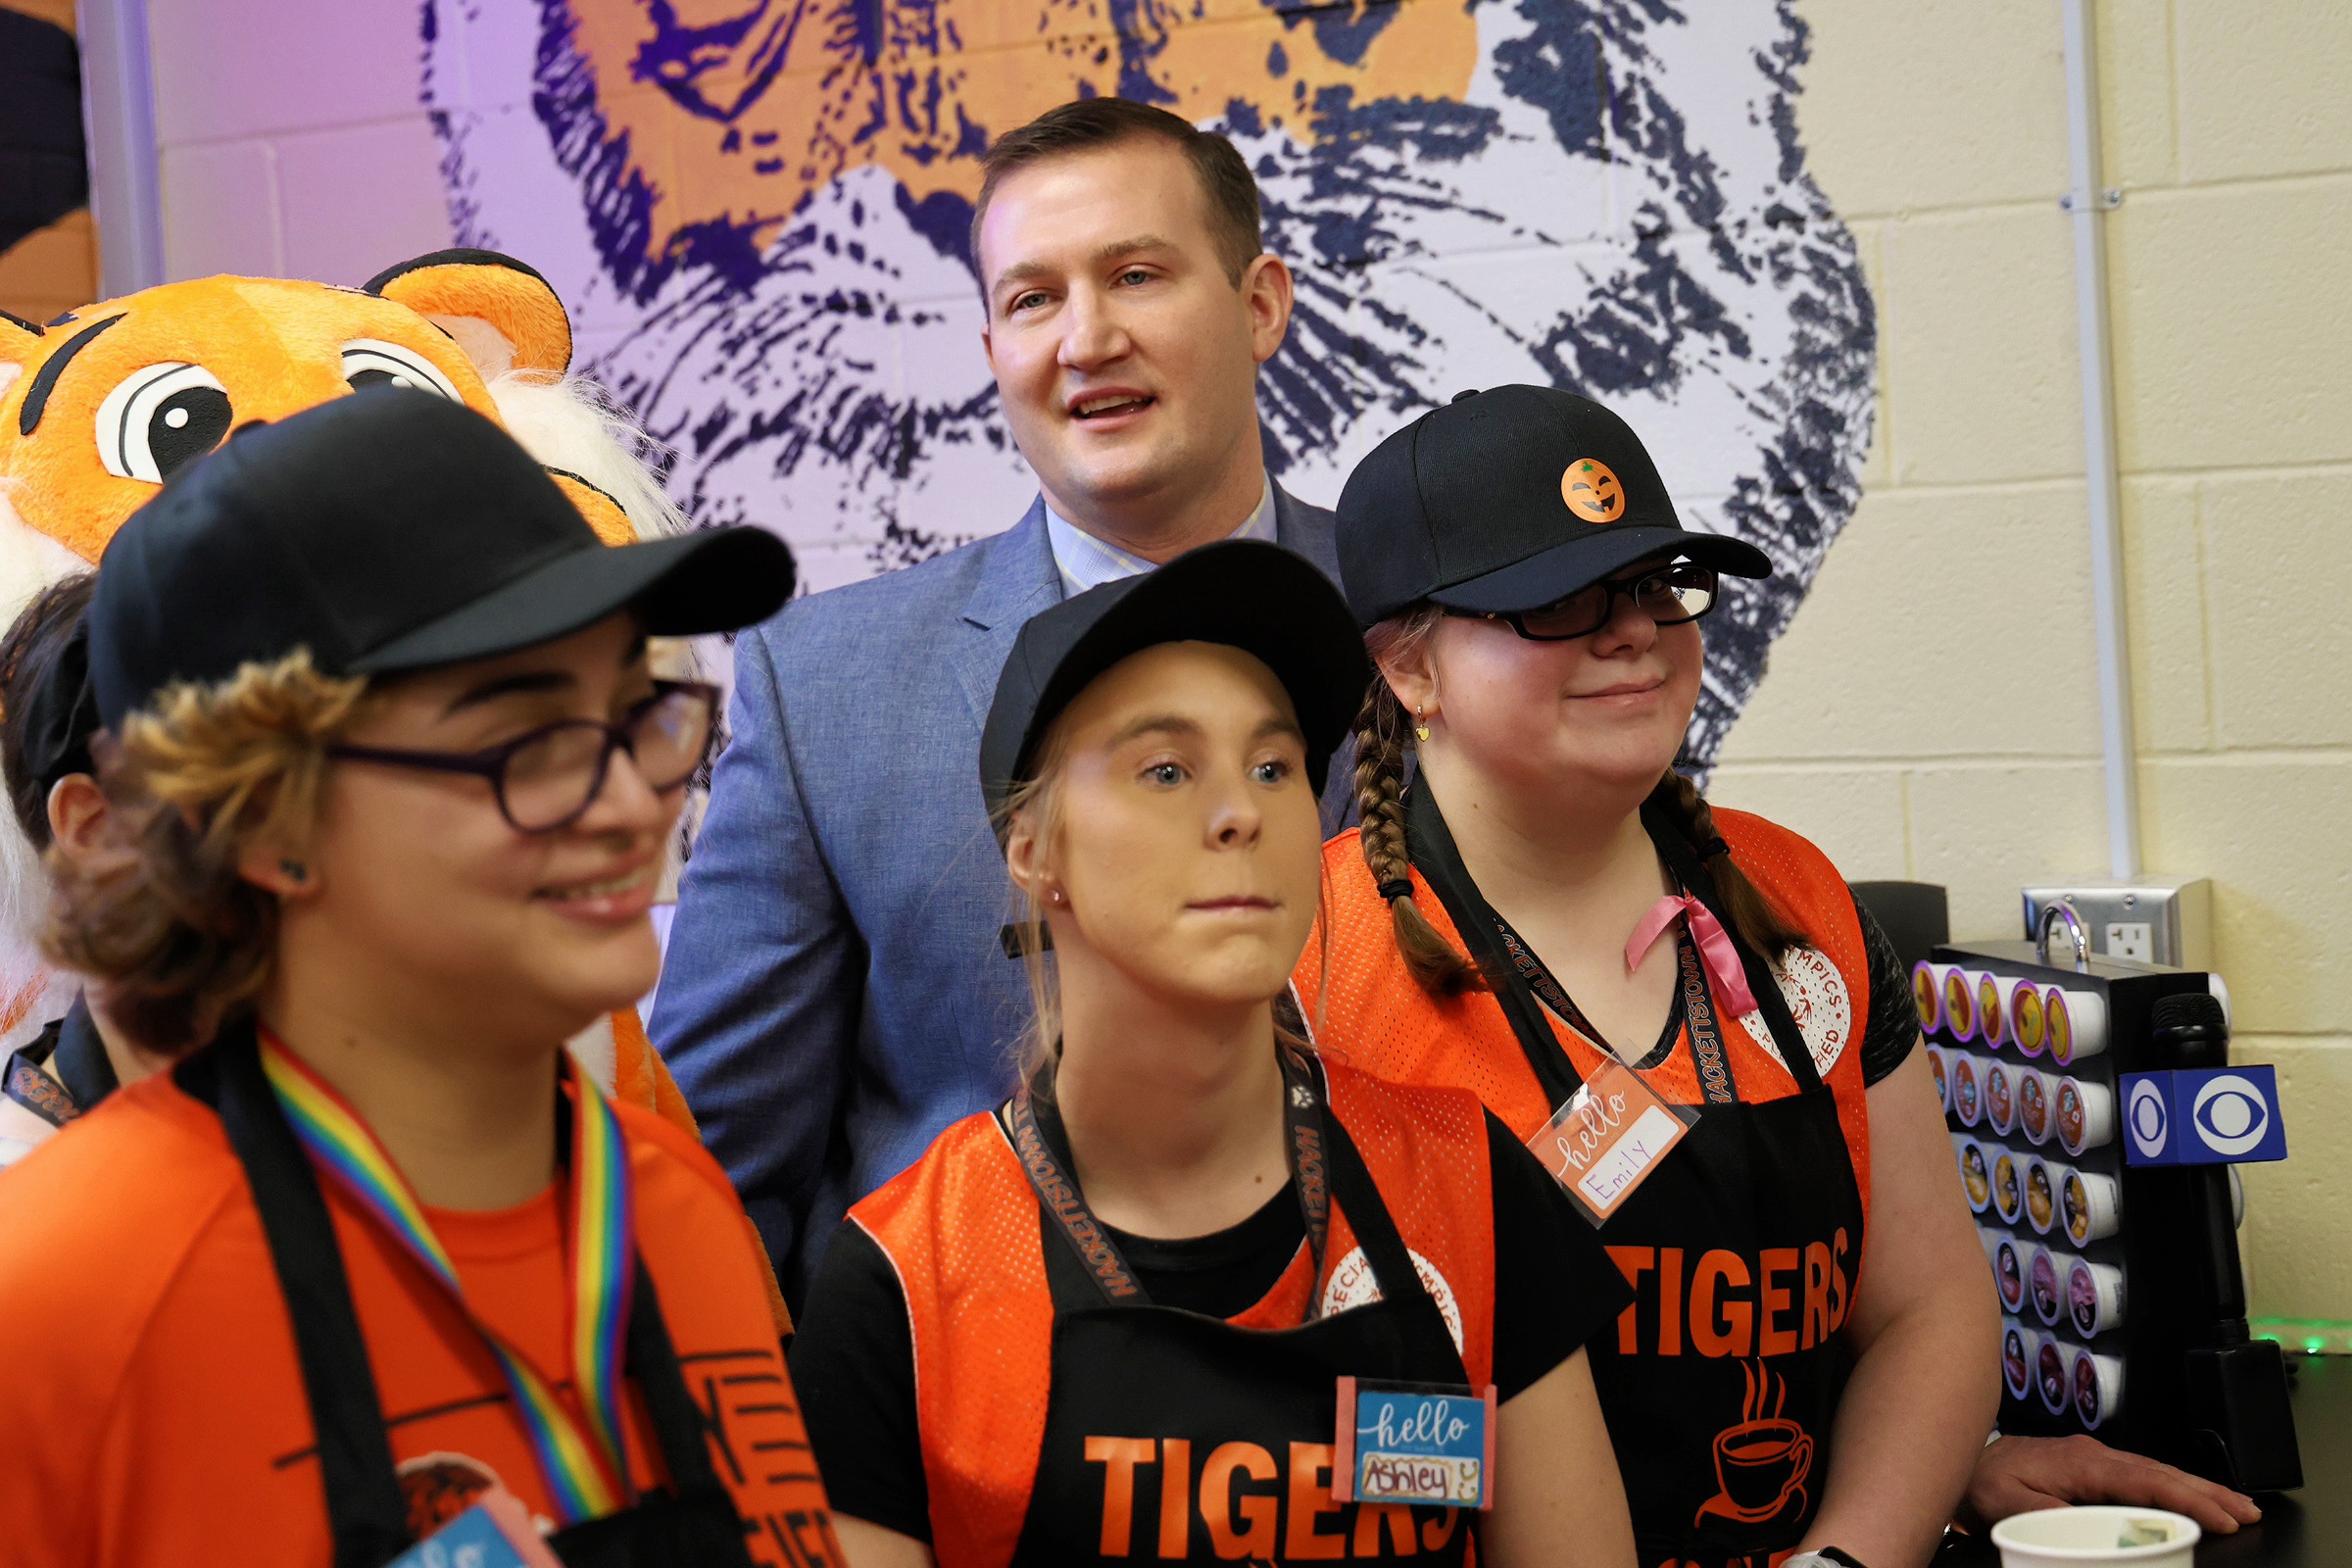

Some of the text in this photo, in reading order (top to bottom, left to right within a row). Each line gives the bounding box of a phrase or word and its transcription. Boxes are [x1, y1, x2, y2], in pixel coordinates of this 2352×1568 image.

[1795, 949, 1842, 1008] MPICS
[1814, 1029, 1839, 1068] FIED
[12, 1067, 79, 1120] IGERS
[1557, 1090, 1625, 1177] hello
[1586, 1139, 1653, 1200] Emily
[1017, 1124, 1137, 1297] HACKETTSTOWN
[1330, 1254, 1370, 1315] PECIA
[1603, 1226, 1848, 1358] TIGERS
[1357, 1399, 1469, 1448] hello
[1364, 1458, 1447, 1499] Ashley
